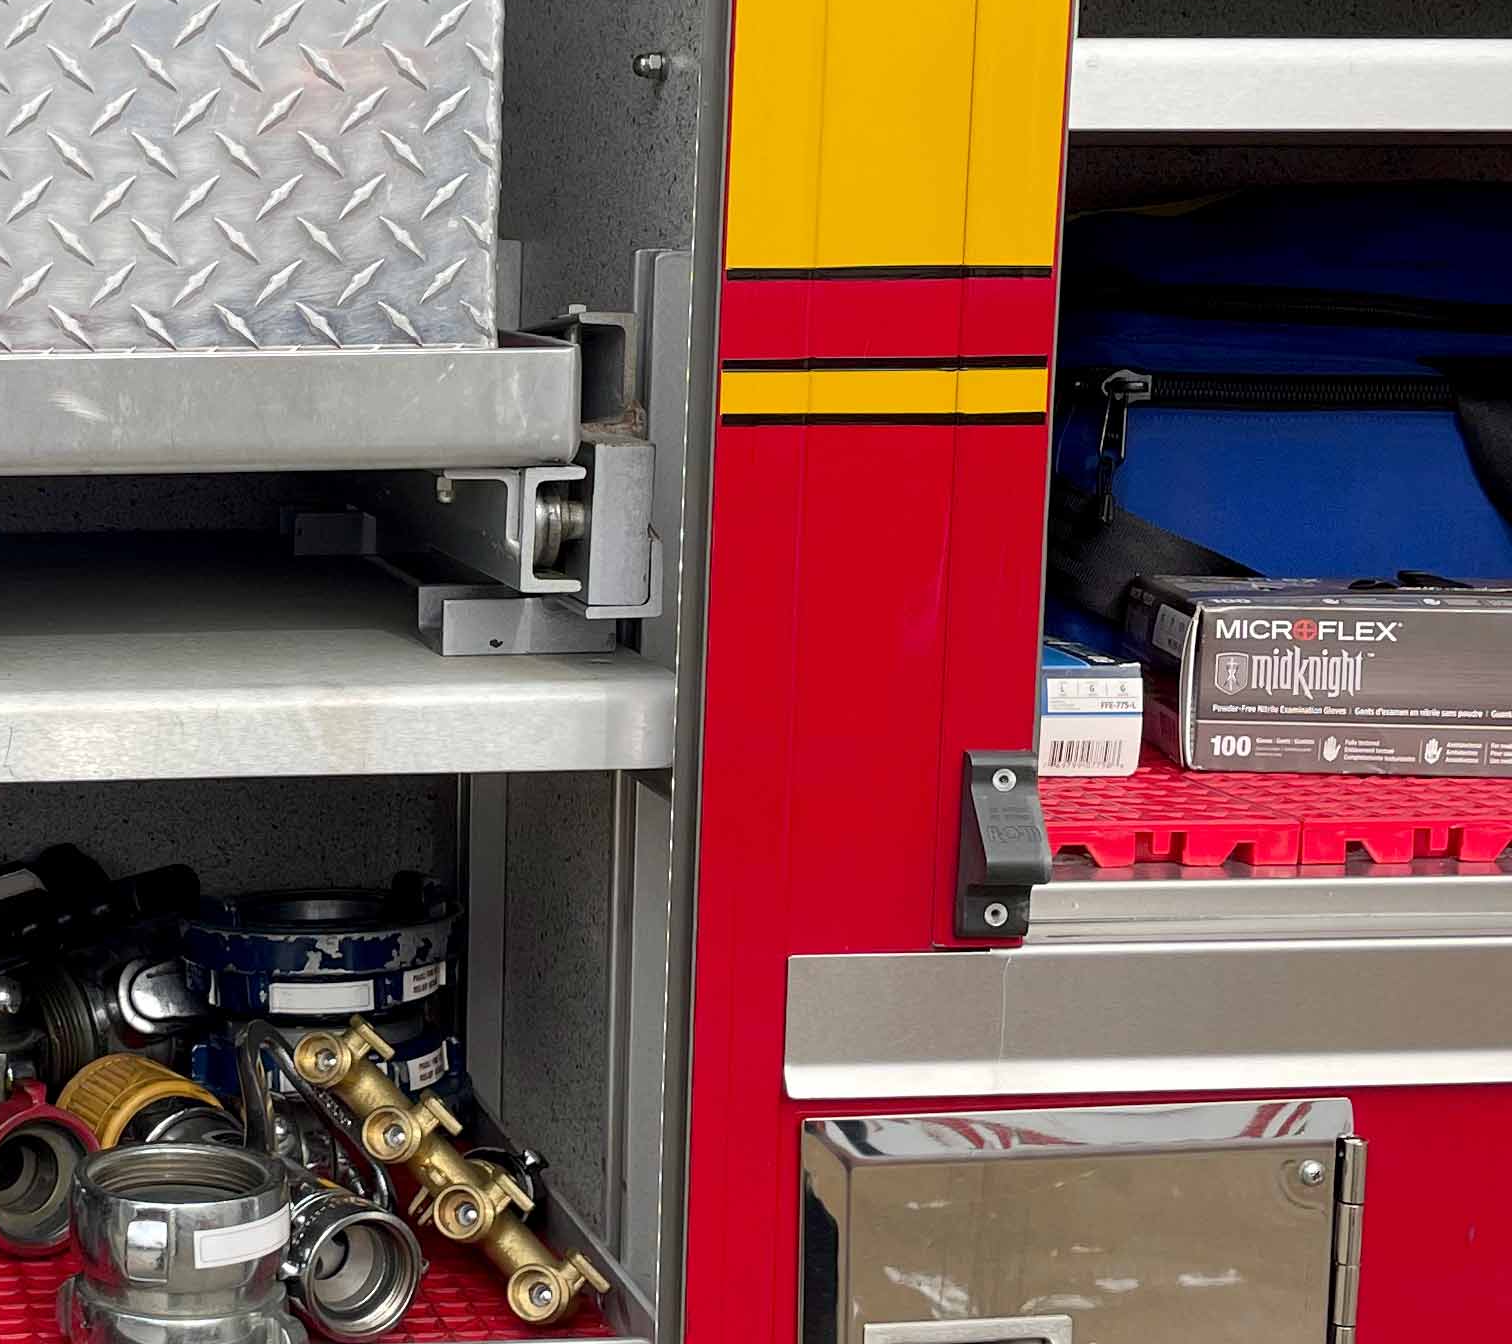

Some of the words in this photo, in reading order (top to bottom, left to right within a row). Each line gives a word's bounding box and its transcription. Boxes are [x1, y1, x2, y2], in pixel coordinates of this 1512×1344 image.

[1216, 619, 1399, 642] MICROFLEX
[1251, 645, 1364, 700] midknight
[1210, 735, 1252, 757] 100
